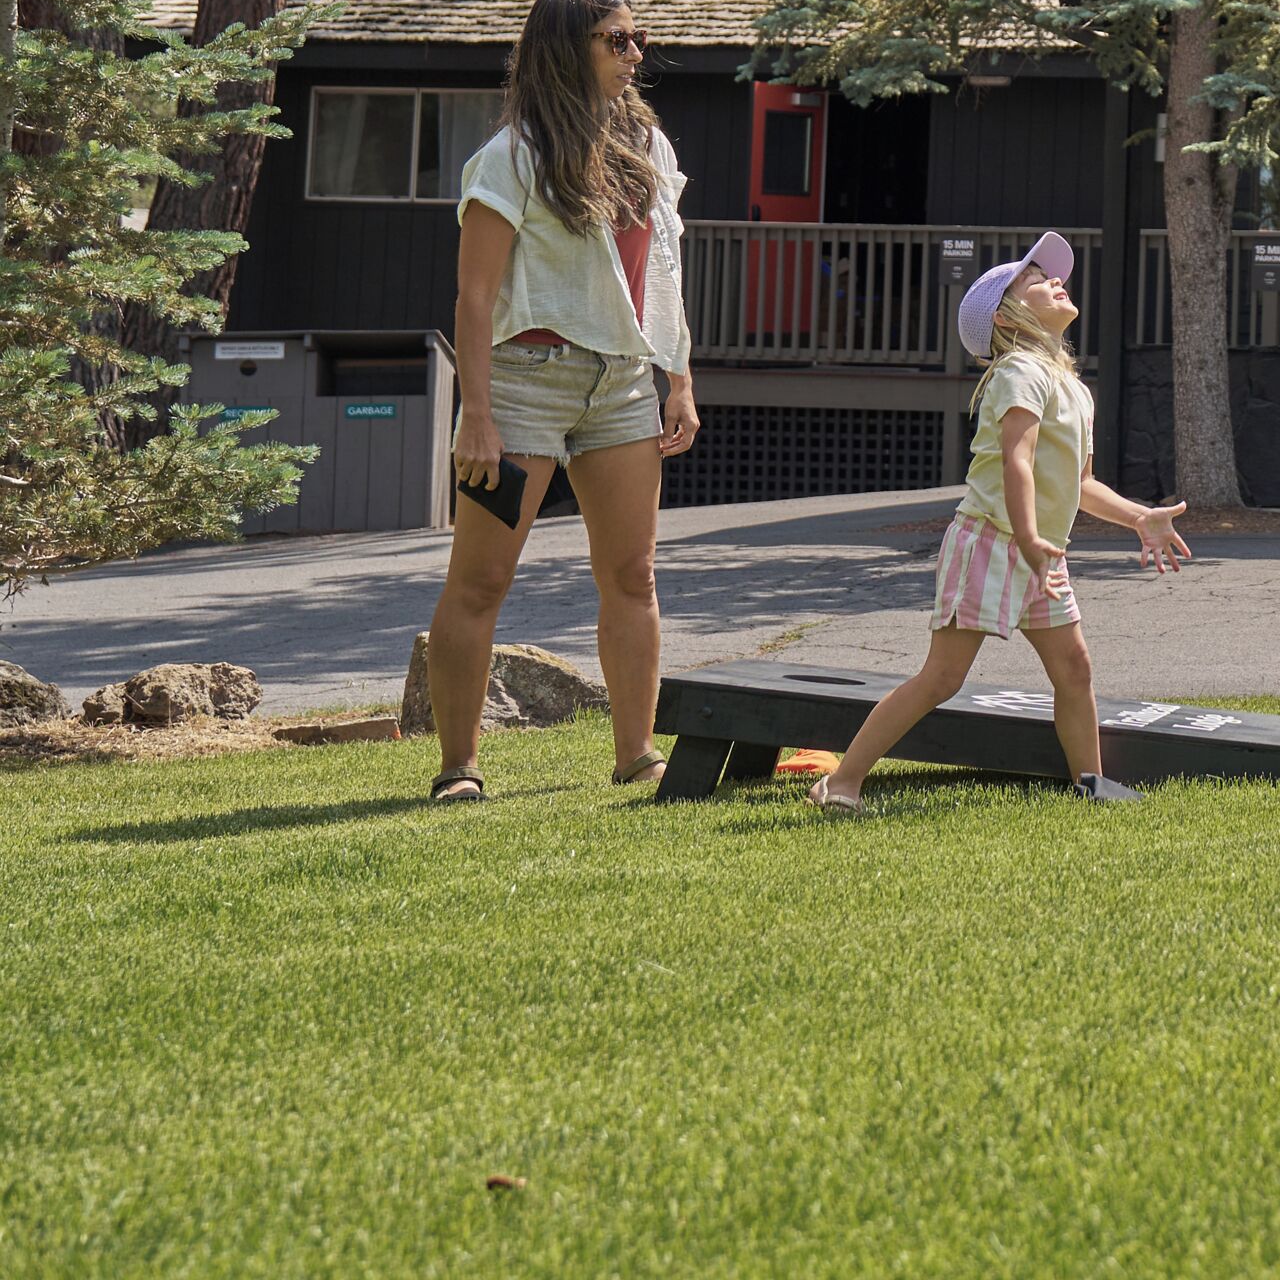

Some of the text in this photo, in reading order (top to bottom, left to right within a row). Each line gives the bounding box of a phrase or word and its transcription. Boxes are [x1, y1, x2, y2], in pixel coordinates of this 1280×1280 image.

[943, 240, 974, 249] 15 MIN
[1254, 245, 1265, 254] 15
[347, 406, 393, 415] GARBAGE
